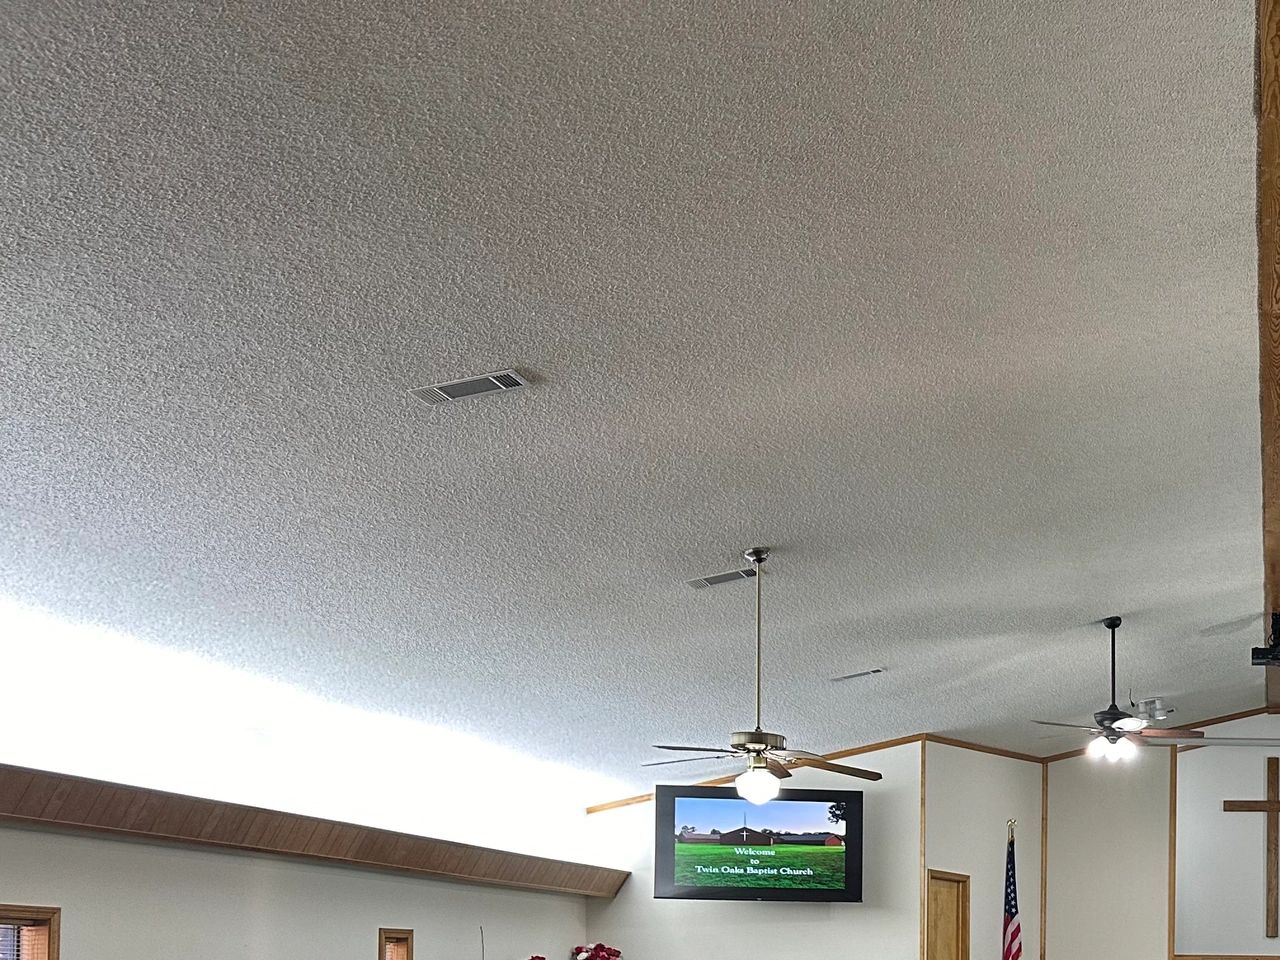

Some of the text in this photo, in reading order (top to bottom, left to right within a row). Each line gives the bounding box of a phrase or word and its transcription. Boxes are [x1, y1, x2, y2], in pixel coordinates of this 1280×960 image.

[734, 847, 776, 856] Welcome
[694, 865, 814, 876] Twin Oaks Baptist Church
